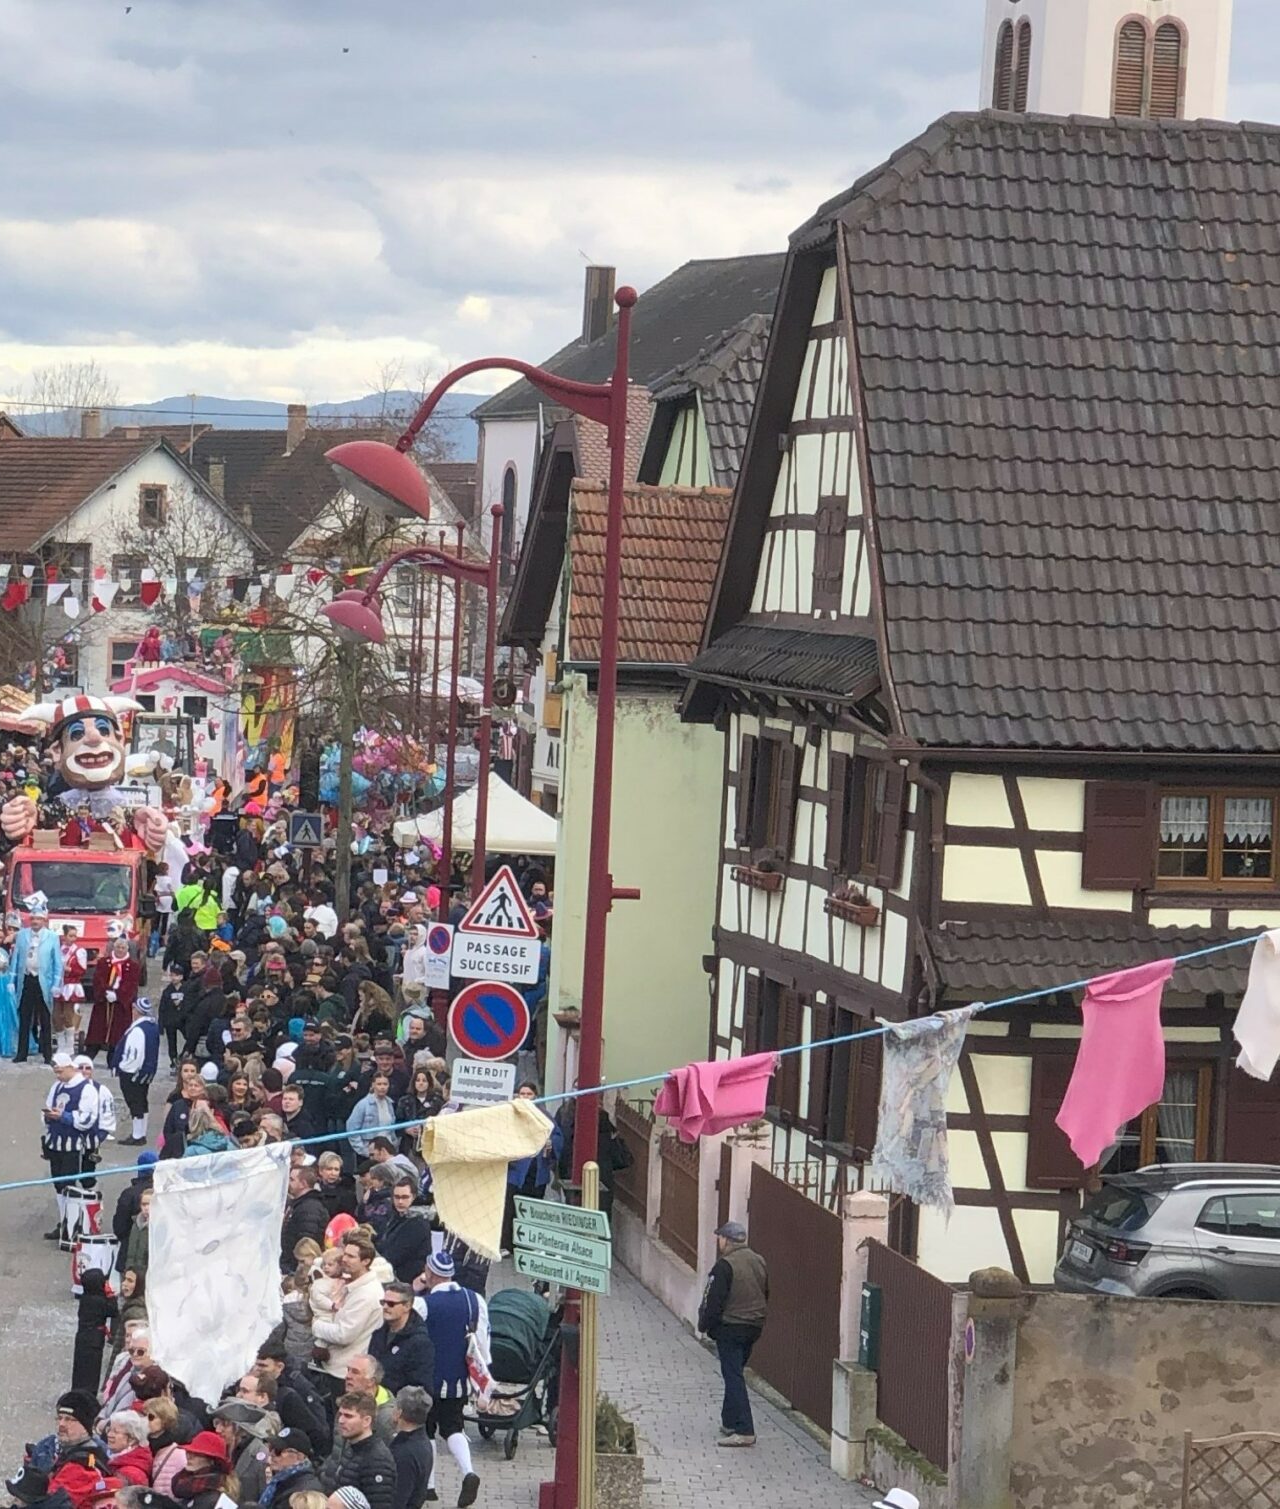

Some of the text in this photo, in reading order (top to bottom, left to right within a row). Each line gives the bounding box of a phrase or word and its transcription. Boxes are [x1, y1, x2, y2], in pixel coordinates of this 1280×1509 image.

[466, 942, 528, 958] PASSAGE
[459, 959, 532, 976] SUCCESSIF
[459, 1065, 509, 1078] INTERDIT
[561, 1212, 597, 1230] RIEDINGER
[528, 1230, 537, 1243] La
[571, 1241, 594, 1258] Alsace
[529, 1259, 563, 1279] Restaurant
